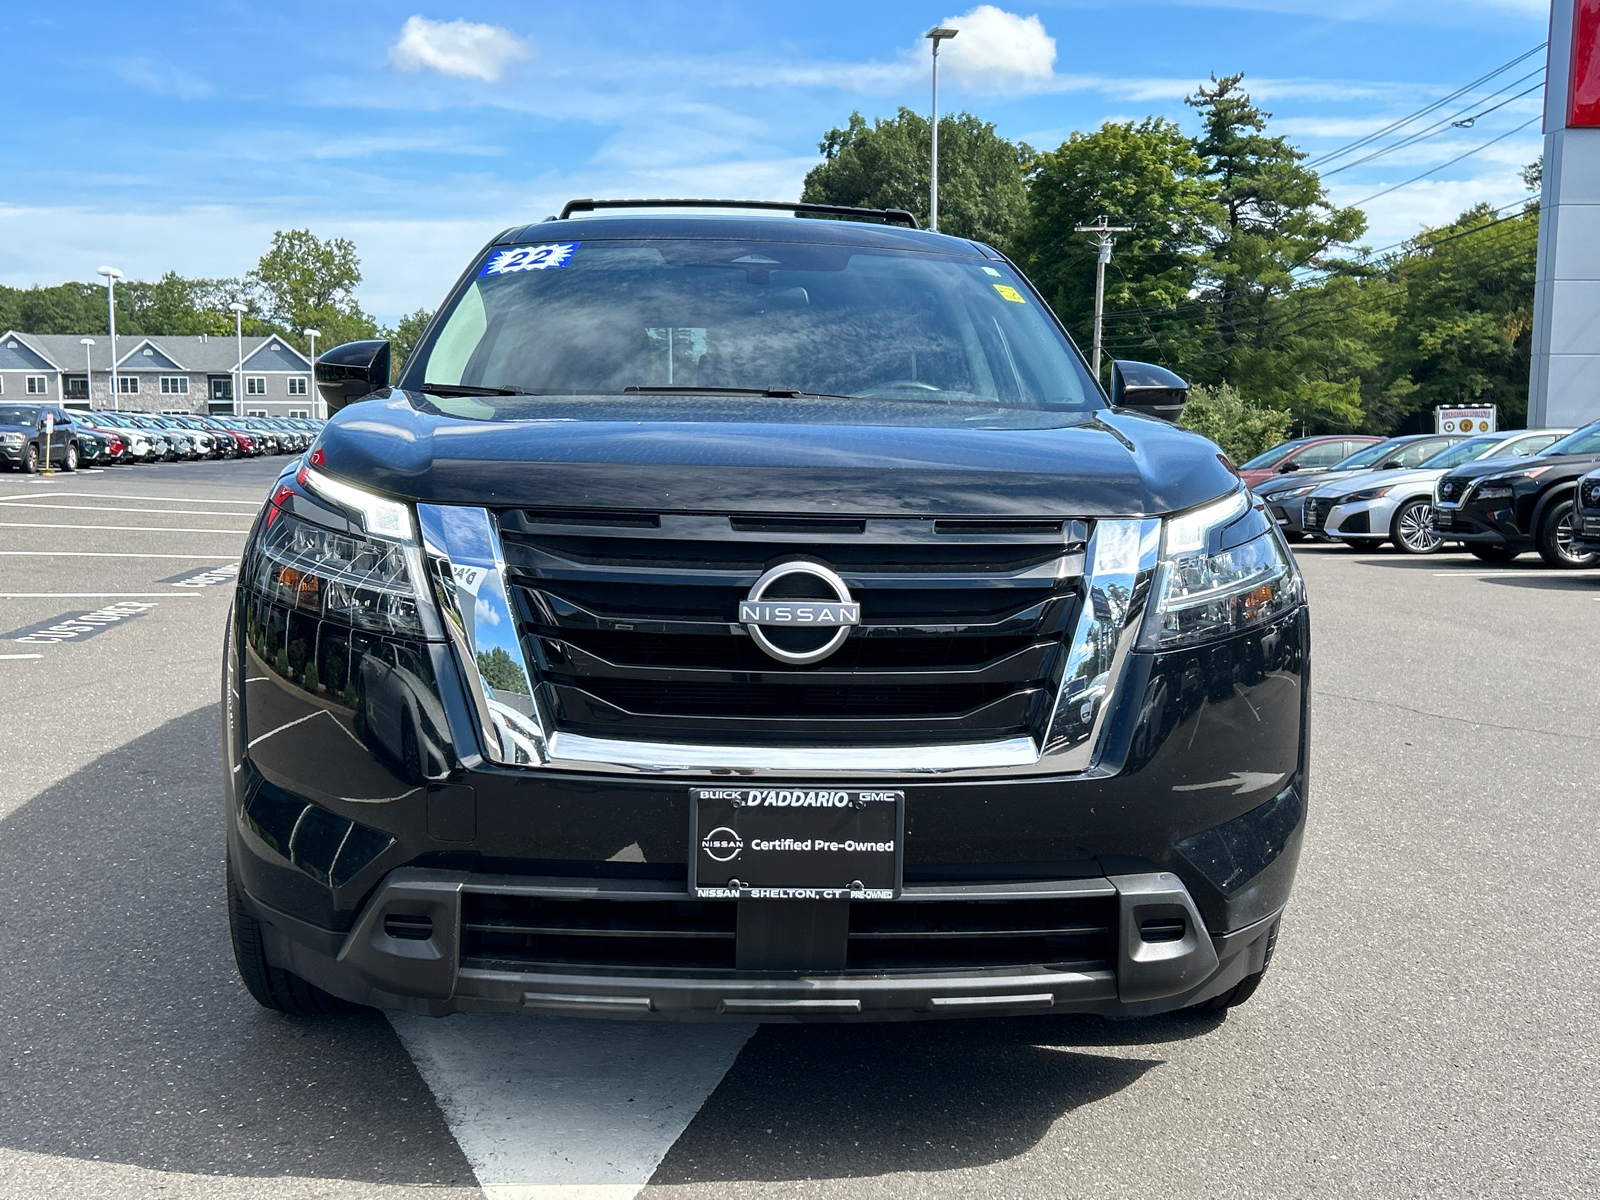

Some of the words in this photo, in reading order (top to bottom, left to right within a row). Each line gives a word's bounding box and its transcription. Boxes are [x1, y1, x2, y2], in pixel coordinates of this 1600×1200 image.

[503, 249, 553, 268] 22
[15, 601, 159, 643] CUSTOMER
[742, 606, 857, 622] NISSAN
[700, 791, 741, 799] BUICK
[747, 790, 849, 807] D'ADDARIO
[859, 793, 895, 801] GMC
[702, 840, 744, 848] NISSAN
[751, 838, 811, 851] Certified
[815, 839, 894, 852] Pre-Owned
[697, 889, 740, 898] NISSAN
[750, 890, 819, 899] SHELTON,
[823, 890, 842, 899] CT
[850, 891, 893, 899] PRE-OWNED
